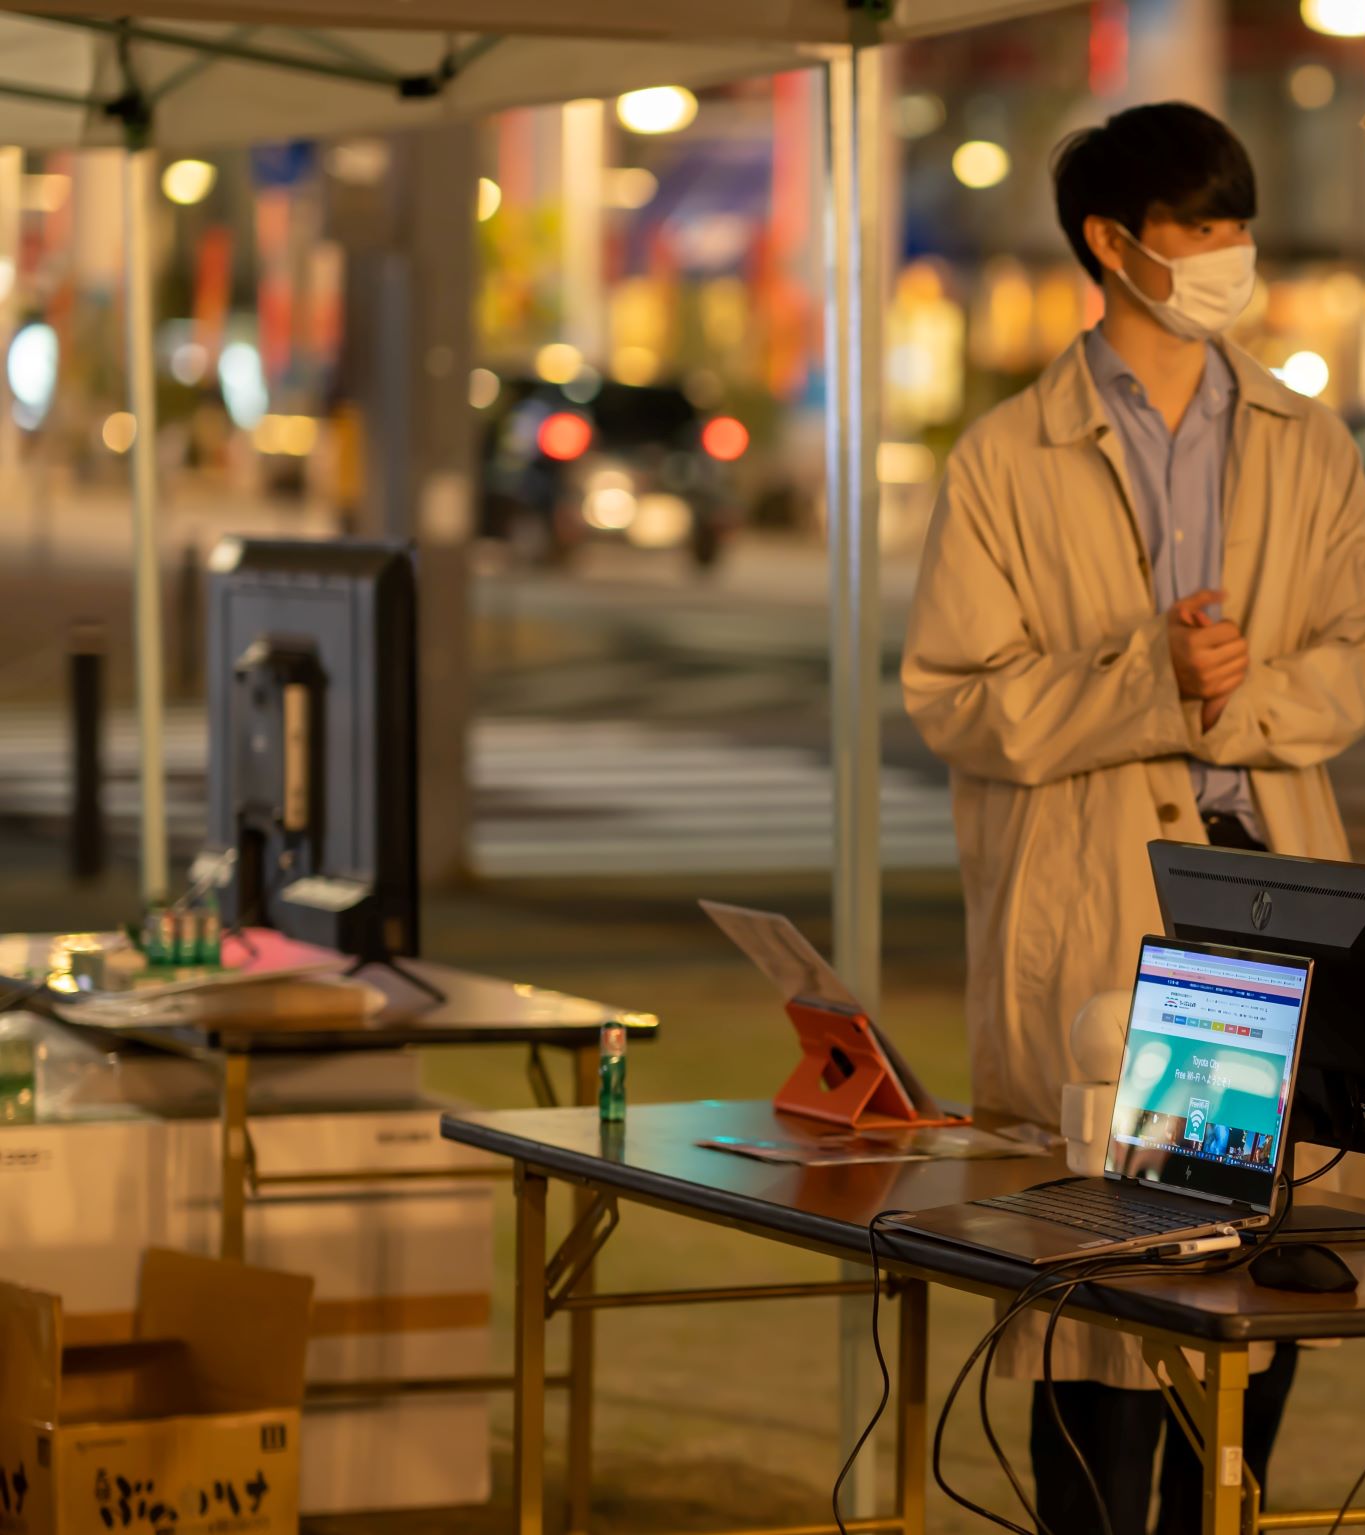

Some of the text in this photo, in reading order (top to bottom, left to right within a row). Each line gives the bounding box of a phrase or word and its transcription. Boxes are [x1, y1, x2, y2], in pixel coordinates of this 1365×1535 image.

[1193, 1056, 1208, 1068] Toyota
[1175, 1069, 1186, 1080] Free
[1187, 1072, 1201, 1082] Wi-Fi
